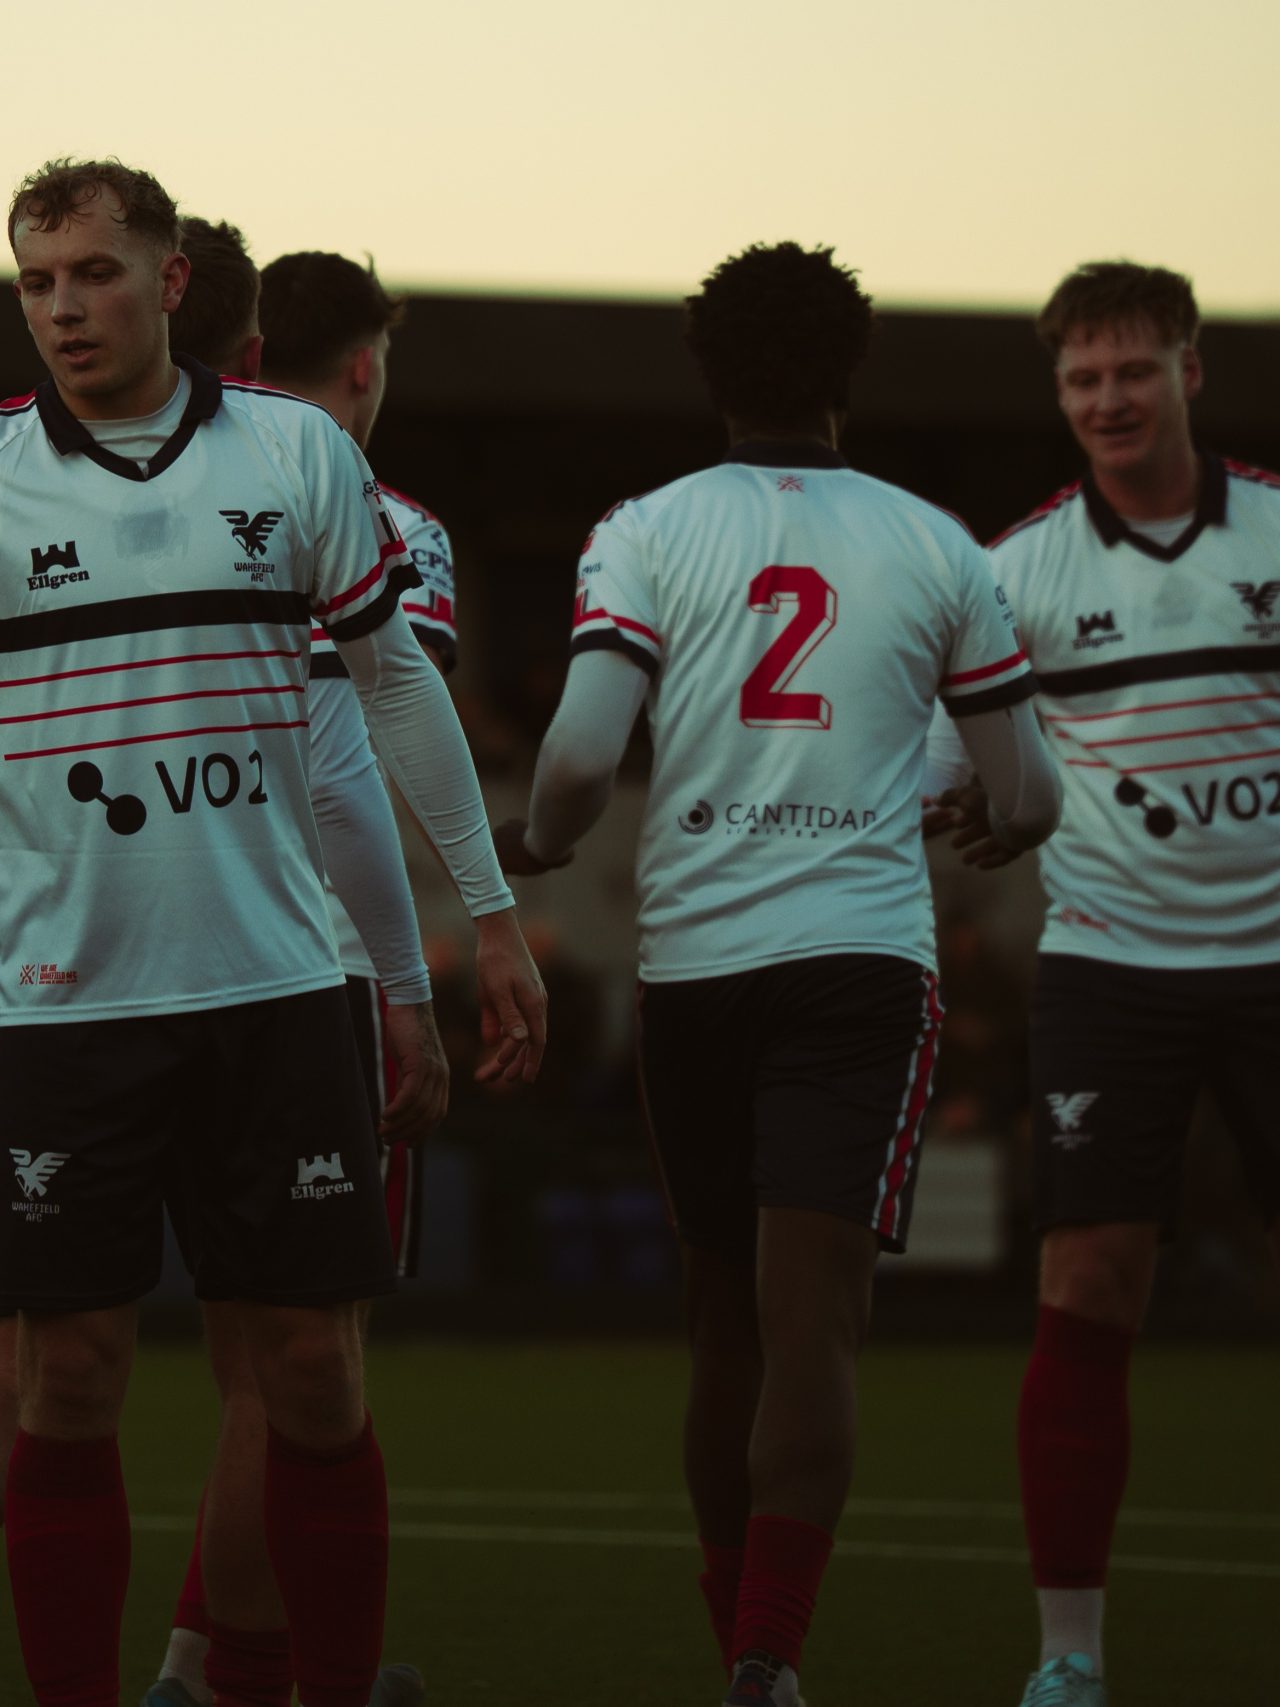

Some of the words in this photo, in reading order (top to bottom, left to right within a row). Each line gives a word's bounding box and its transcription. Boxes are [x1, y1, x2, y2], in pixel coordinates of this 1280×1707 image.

[26, 570, 90, 592] Ellgren
[740, 565, 838, 731] 2
[155, 750, 269, 814] VO2
[290, 1181, 354, 1200] Ellgren
[11, 1201, 60, 1215] WAKEFIELD
[26, 1212, 43, 1223] AFC
